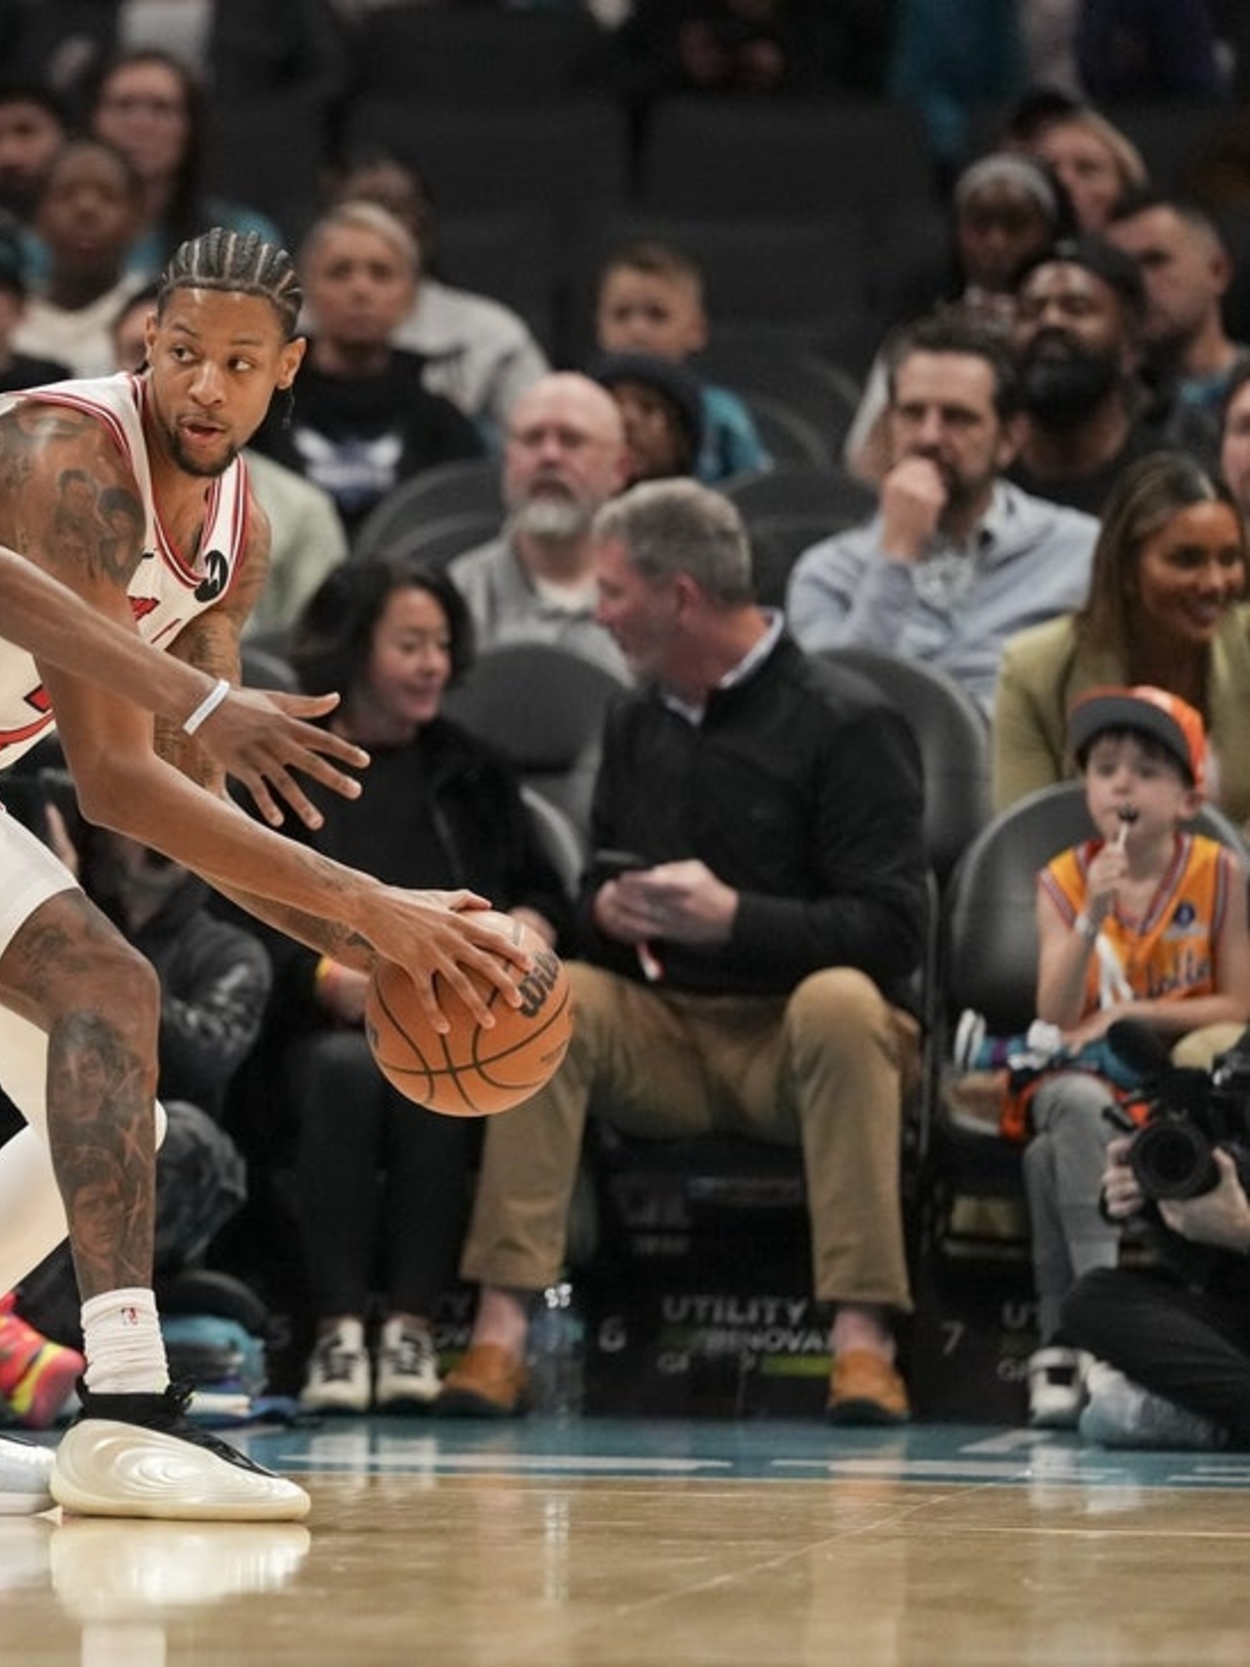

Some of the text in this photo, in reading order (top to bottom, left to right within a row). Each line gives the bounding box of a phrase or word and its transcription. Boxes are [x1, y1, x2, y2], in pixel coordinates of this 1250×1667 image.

[661, 1296, 807, 1325] UTILITY
[599, 1315, 626, 1351] 6
[941, 1320, 965, 1355] 7
